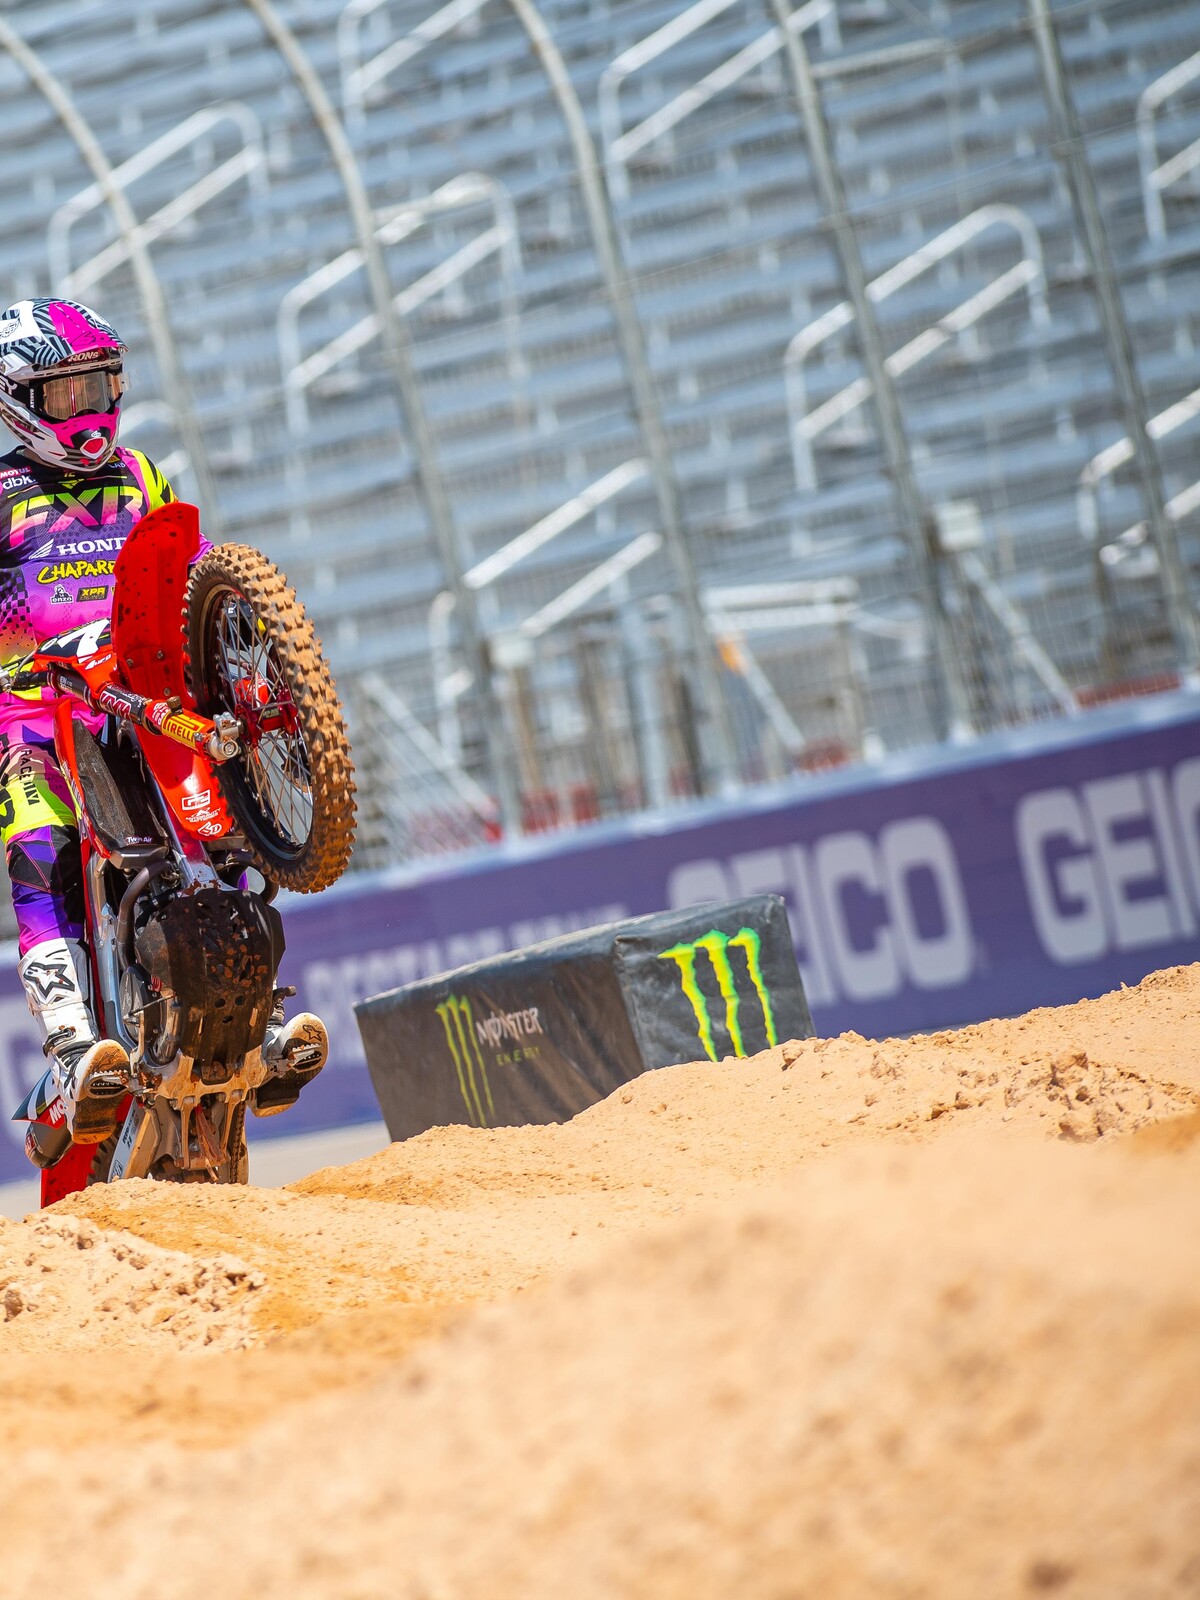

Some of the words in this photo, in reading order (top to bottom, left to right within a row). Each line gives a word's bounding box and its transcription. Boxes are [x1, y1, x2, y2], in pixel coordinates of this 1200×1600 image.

[0, 467, 31, 478] MOTUL
[9, 486, 143, 548] FXR
[56, 537, 127, 556] HOND
[37, 560, 115, 584] CHAPARR
[667, 816, 973, 1005] ICO
[476, 1007, 543, 1047] MONSTER
